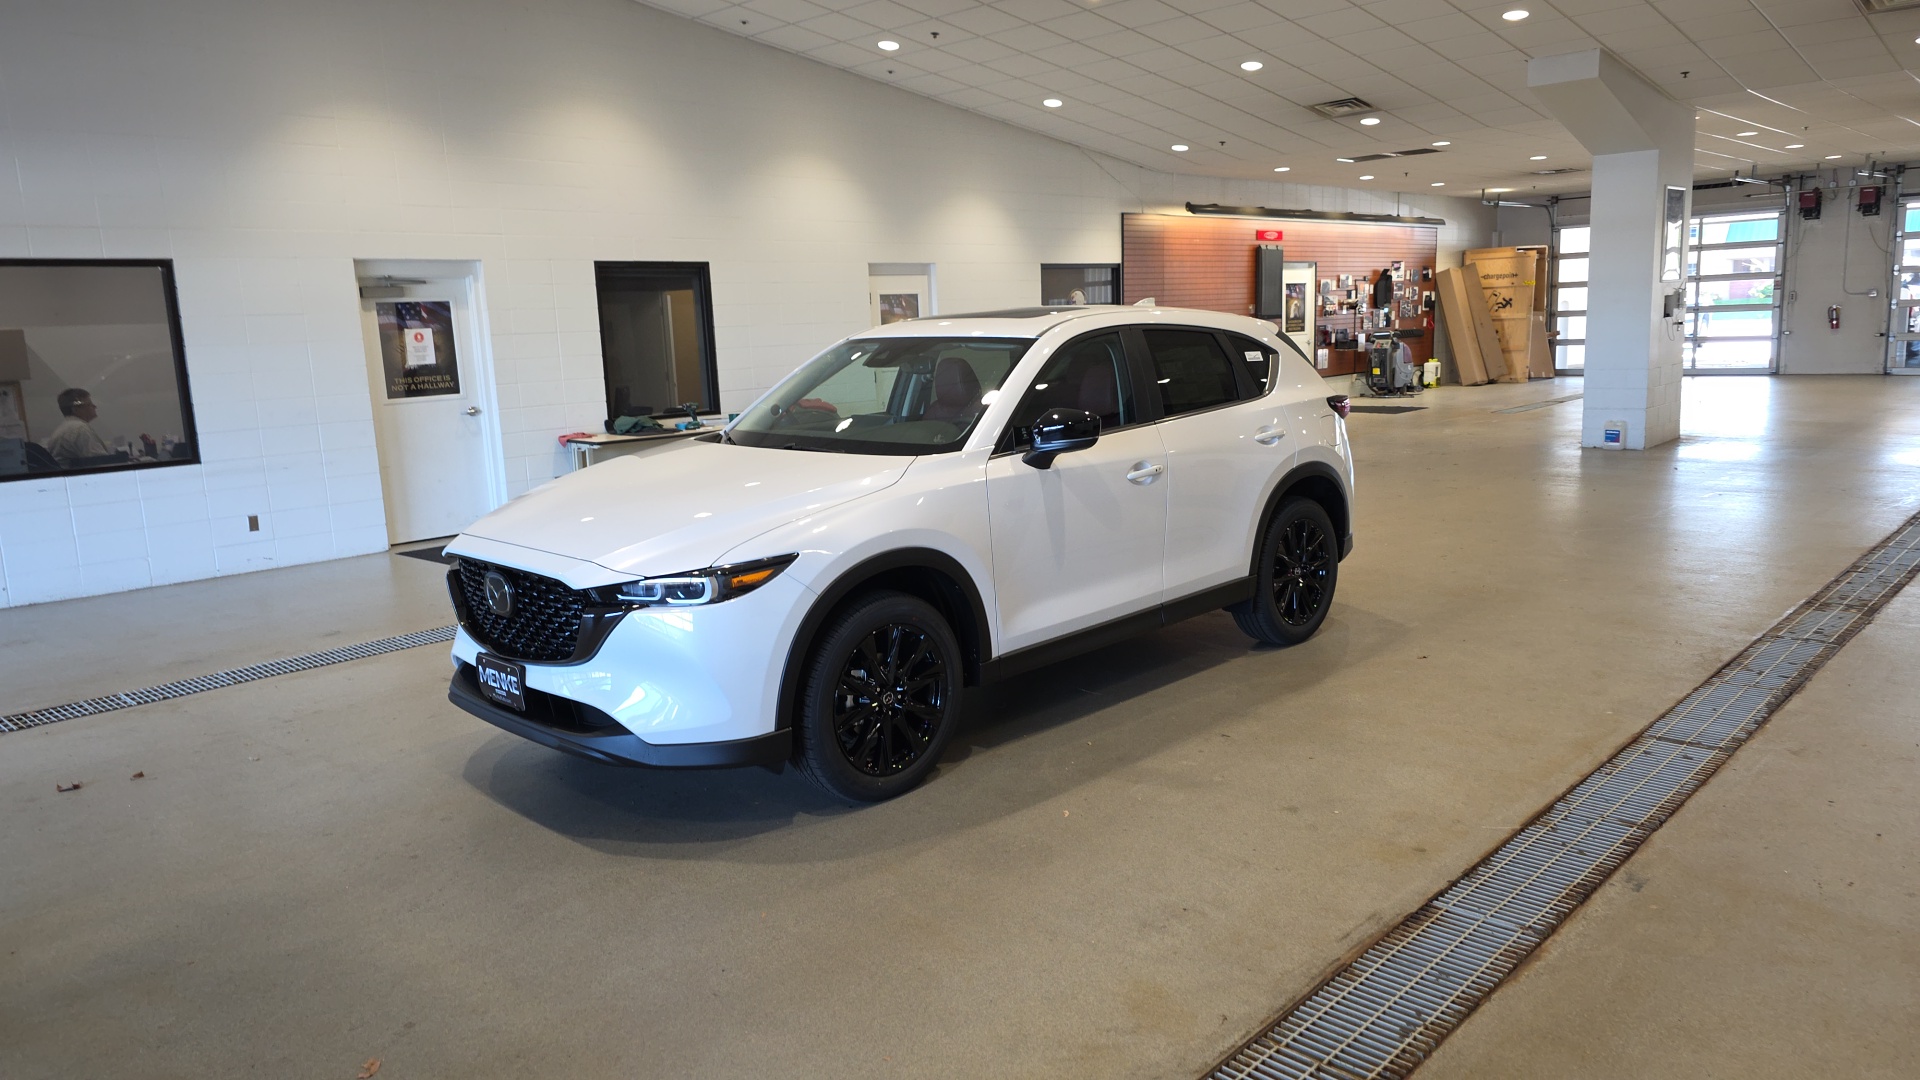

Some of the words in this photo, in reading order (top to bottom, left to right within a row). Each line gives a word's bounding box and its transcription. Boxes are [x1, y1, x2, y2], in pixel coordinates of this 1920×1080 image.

[414, 375, 442, 383] OFFICE
[417, 381, 454, 390] HALLWAY
[478, 665, 519, 695] MENKE
